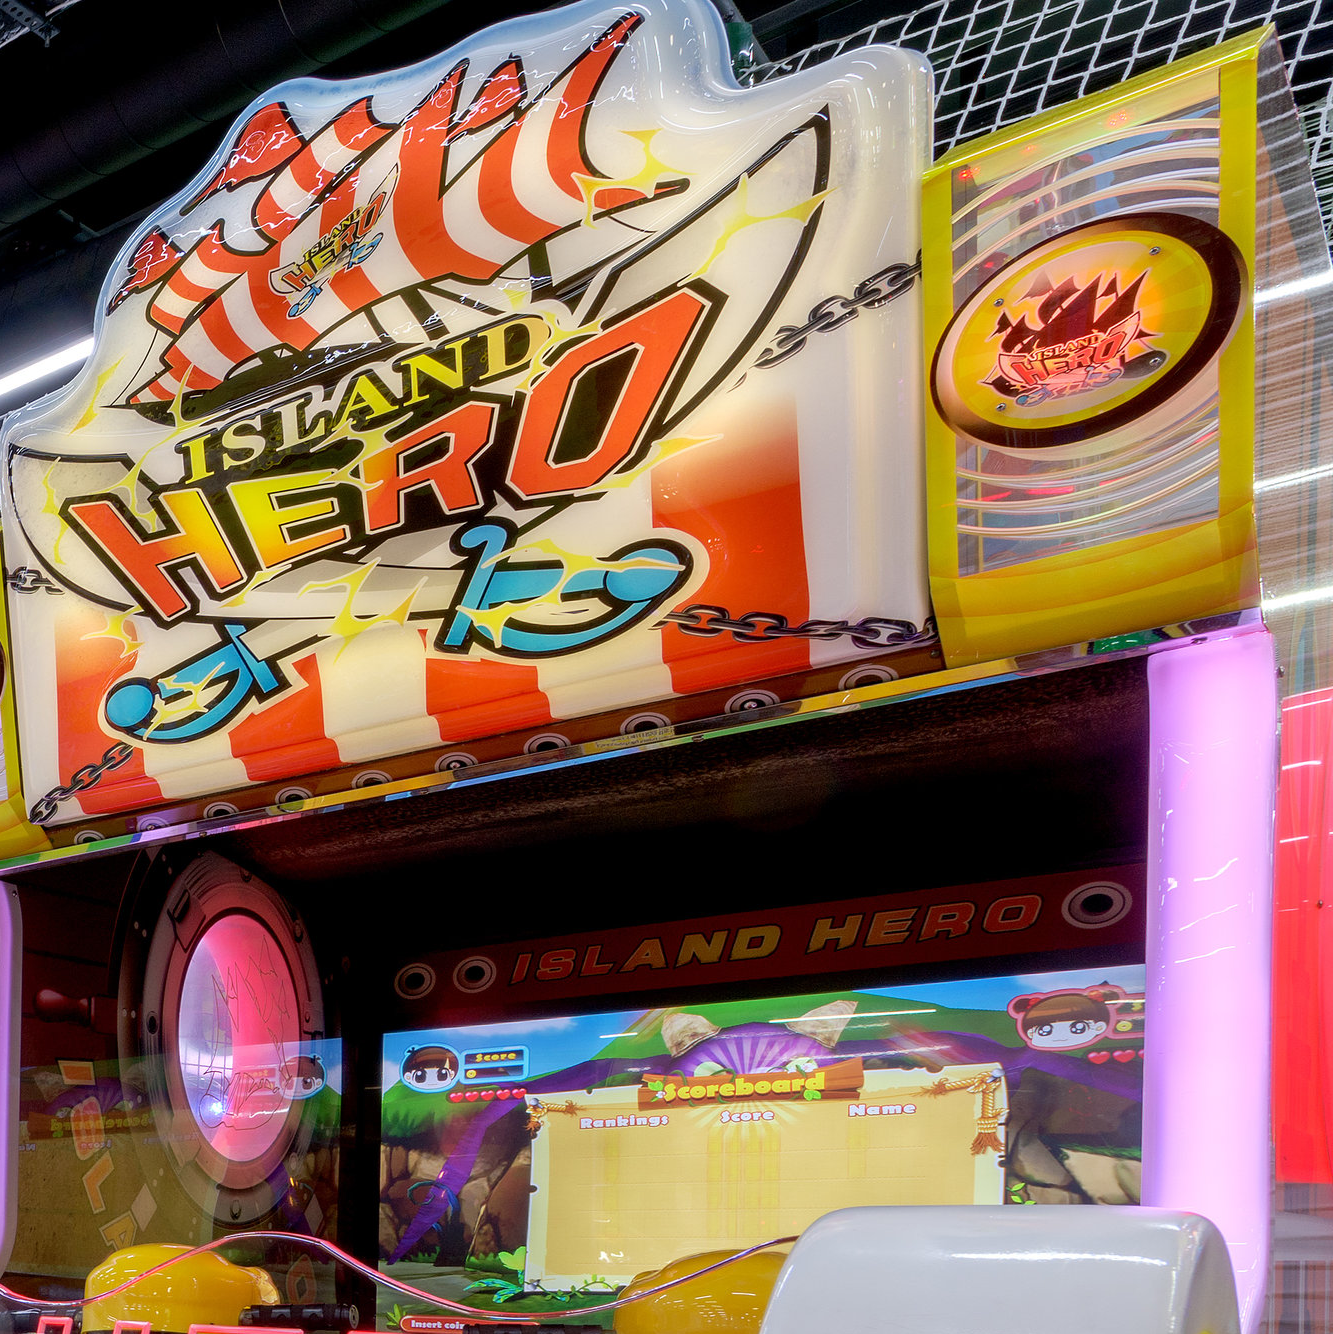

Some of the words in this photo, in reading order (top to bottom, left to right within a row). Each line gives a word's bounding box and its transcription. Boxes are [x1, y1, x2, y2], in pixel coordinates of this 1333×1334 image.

[282, 192, 386, 292] HERO
[304, 206, 364, 261] ISLAND
[1011, 331, 1127, 384] HERO
[1035, 334, 1102, 360] ISLAND
[177, 316, 547, 484] ISLAND
[70, 292, 708, 621] HERO
[511, 923, 783, 985] ISLAND
[807, 892, 1045, 955] HERO
[475, 1053, 517, 1063] Score
[664, 1071, 826, 1103] Scoreboard
[579, 1113, 669, 1130] Rankings
[719, 1109, 775, 1124] Score
[847, 1102, 917, 1117] Name
[411, 1320, 442, 1329] Insert
